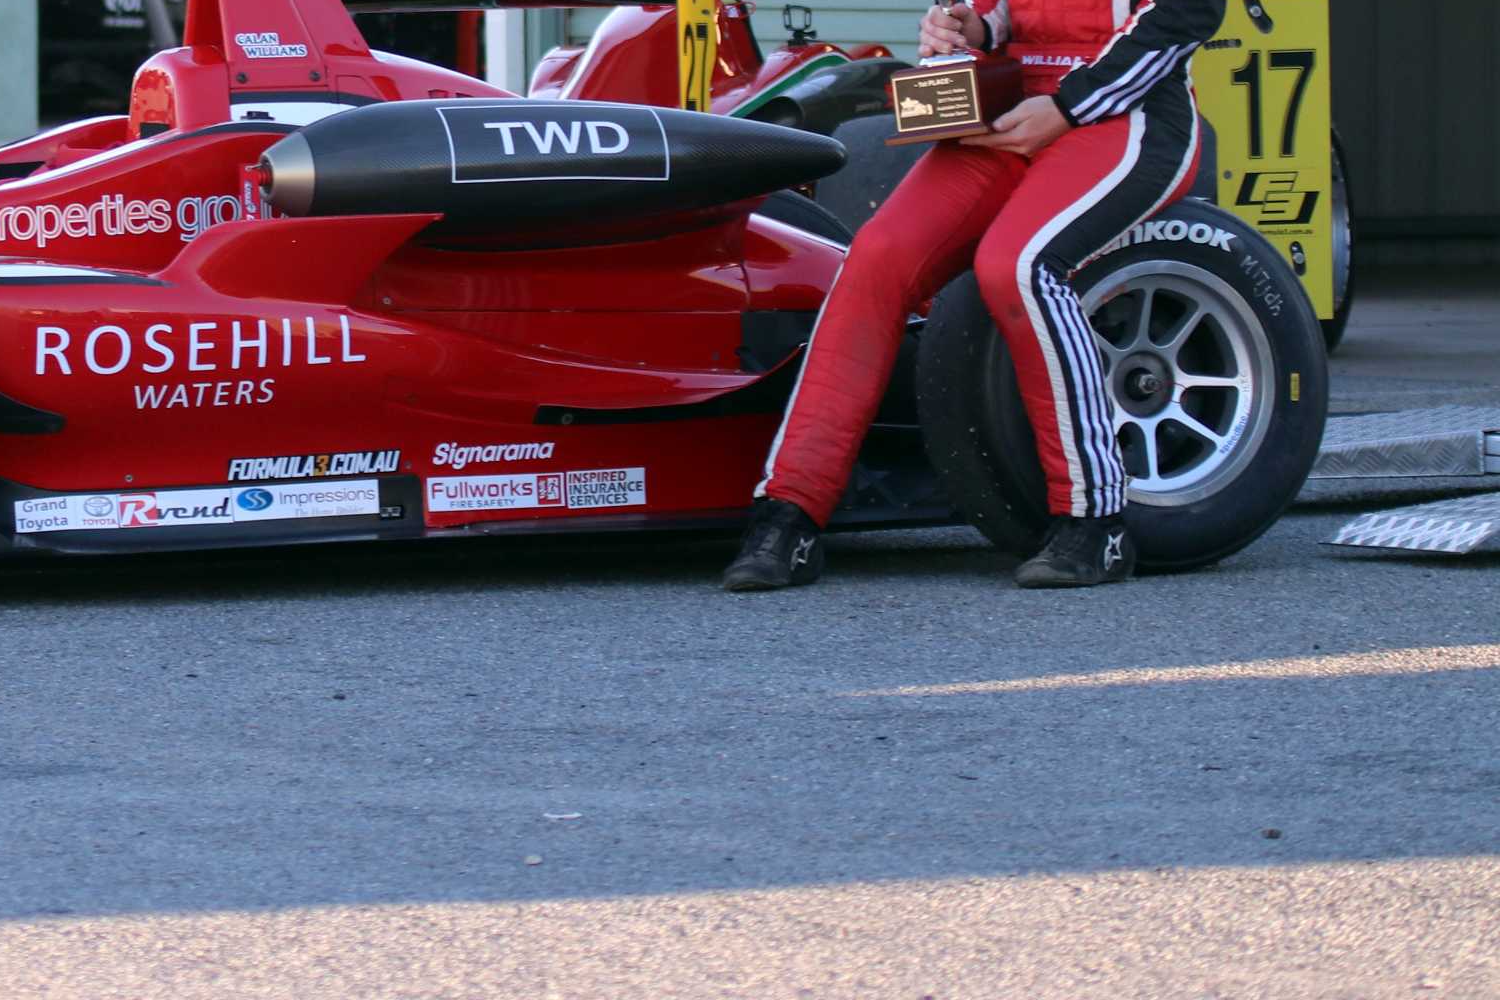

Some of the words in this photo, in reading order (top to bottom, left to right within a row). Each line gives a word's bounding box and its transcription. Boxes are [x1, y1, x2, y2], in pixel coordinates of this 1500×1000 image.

[245, 46, 306, 56] WILLIAMS
[1231, 50, 1316, 159] 17
[483, 121, 630, 155] TWD
[177, 194, 272, 242] gro
[35, 314, 366, 376] ROSEHILL
[133, 378, 275, 410] WATERS
[432, 442, 555, 469] Signarama
[228, 451, 399, 481] FORMULA3.COM.AU
[568, 470, 627, 484] INSPIRED
[279, 487, 375, 508] Impressions
[431, 480, 533, 500] Fullworks
[568, 480, 643, 495] INSURANCE
[22, 498, 67, 512] Grand
[450, 500, 474, 509] FIRE
[476, 498, 516, 508] SAFETY
[569, 492, 628, 507] SERVICES
[18, 515, 68, 532] Toyota
[82, 517, 117, 526] TOYOTA
